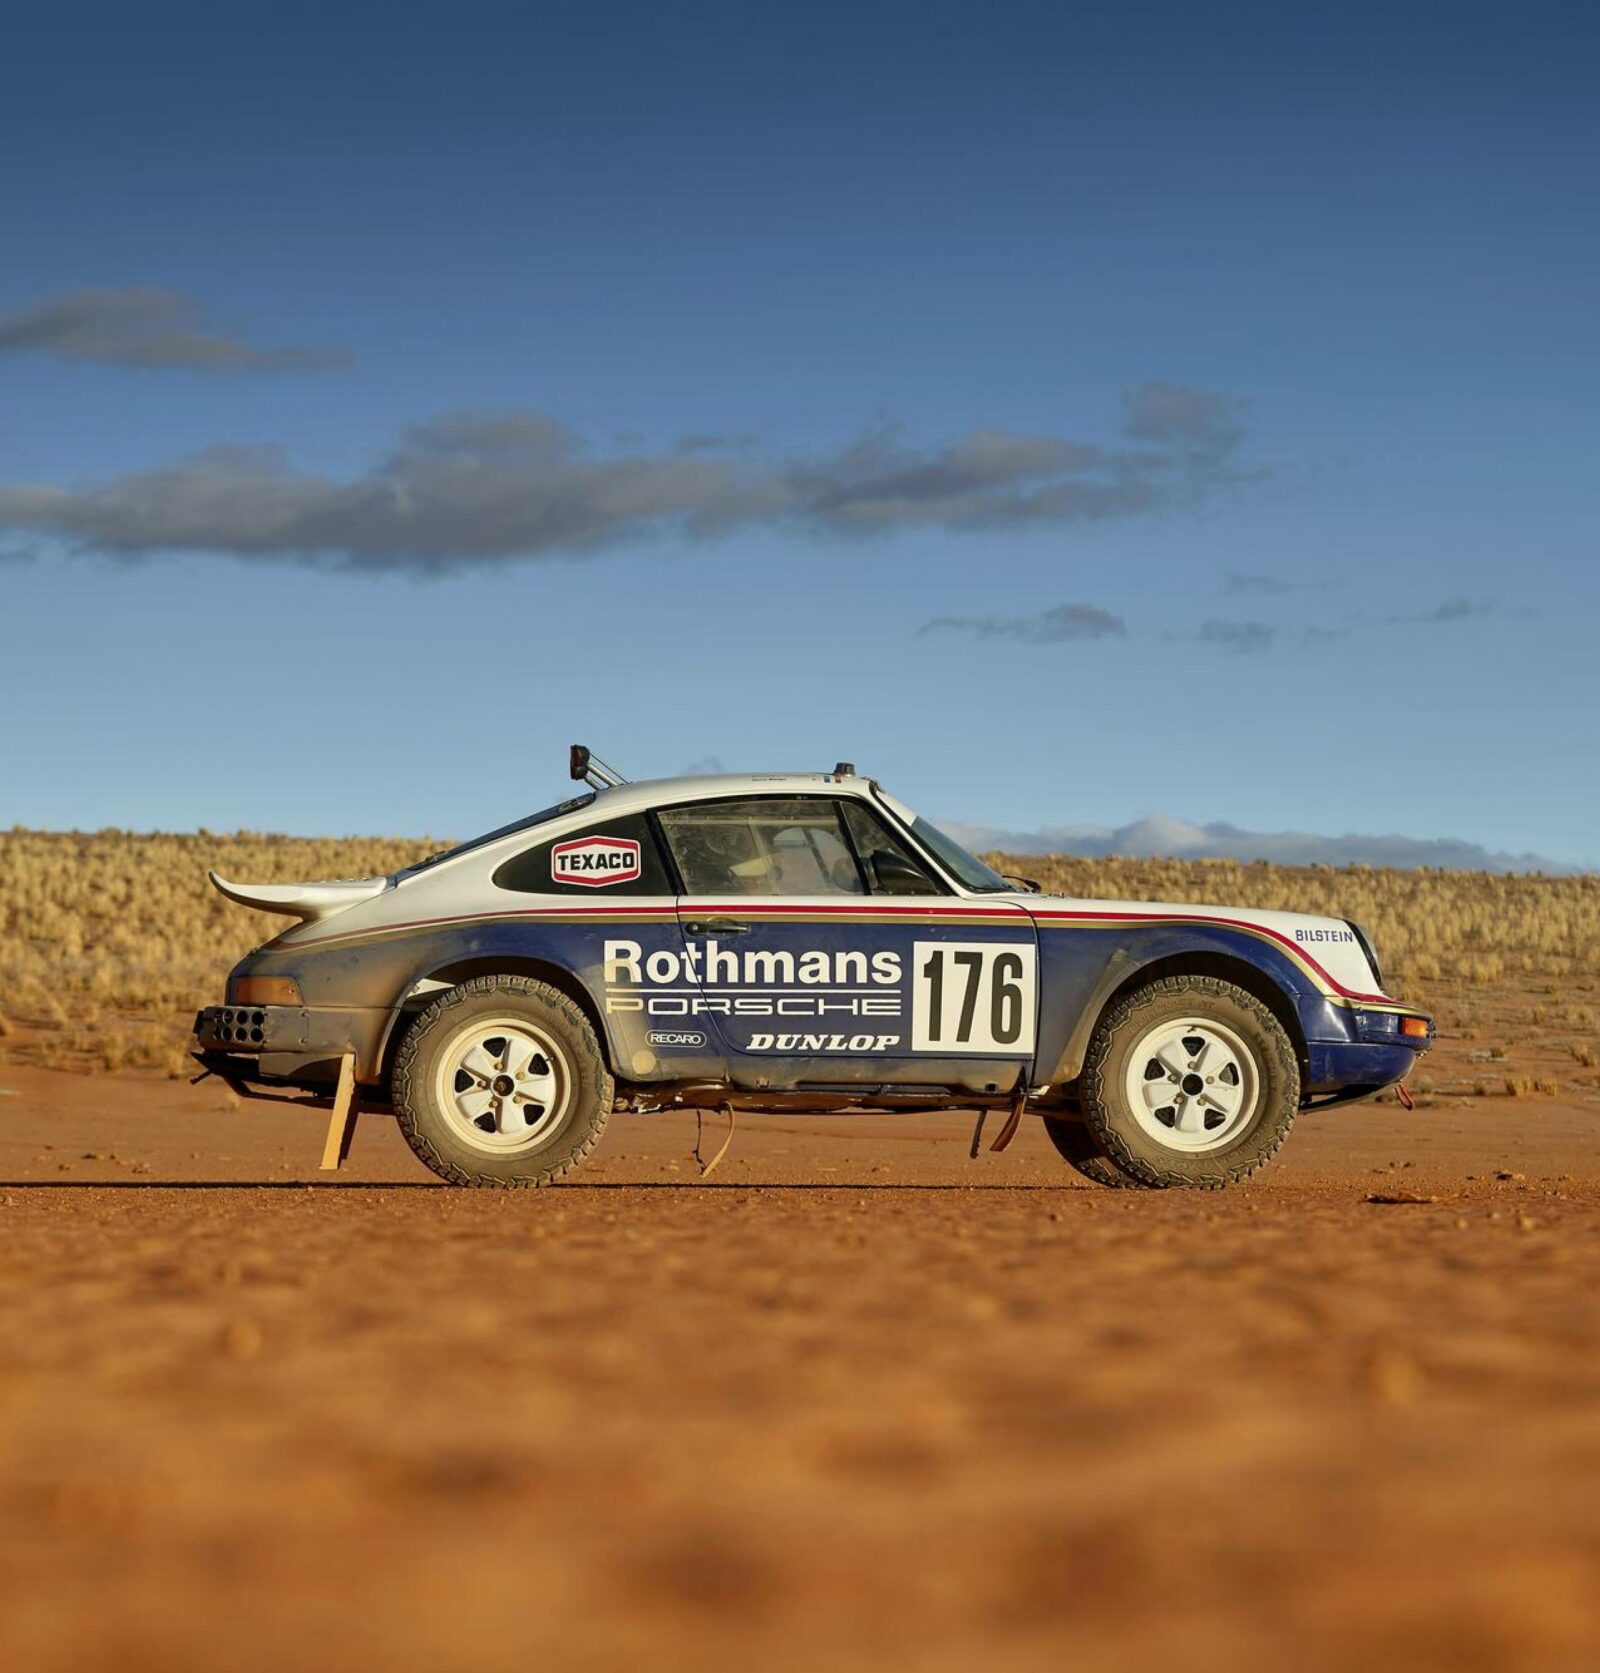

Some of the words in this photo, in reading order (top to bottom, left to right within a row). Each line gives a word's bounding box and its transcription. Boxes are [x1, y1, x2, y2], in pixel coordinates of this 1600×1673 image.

[557, 852, 634, 871] TEXACO
[1295, 929, 1353, 943] BILSTEIN
[603, 940, 903, 984] Rothmans
[923, 950, 1023, 1044] 176
[606, 998, 902, 1016] PORSCHE
[650, 1033, 702, 1045] RECARO
[746, 1034, 901, 1051] DUNLOP
